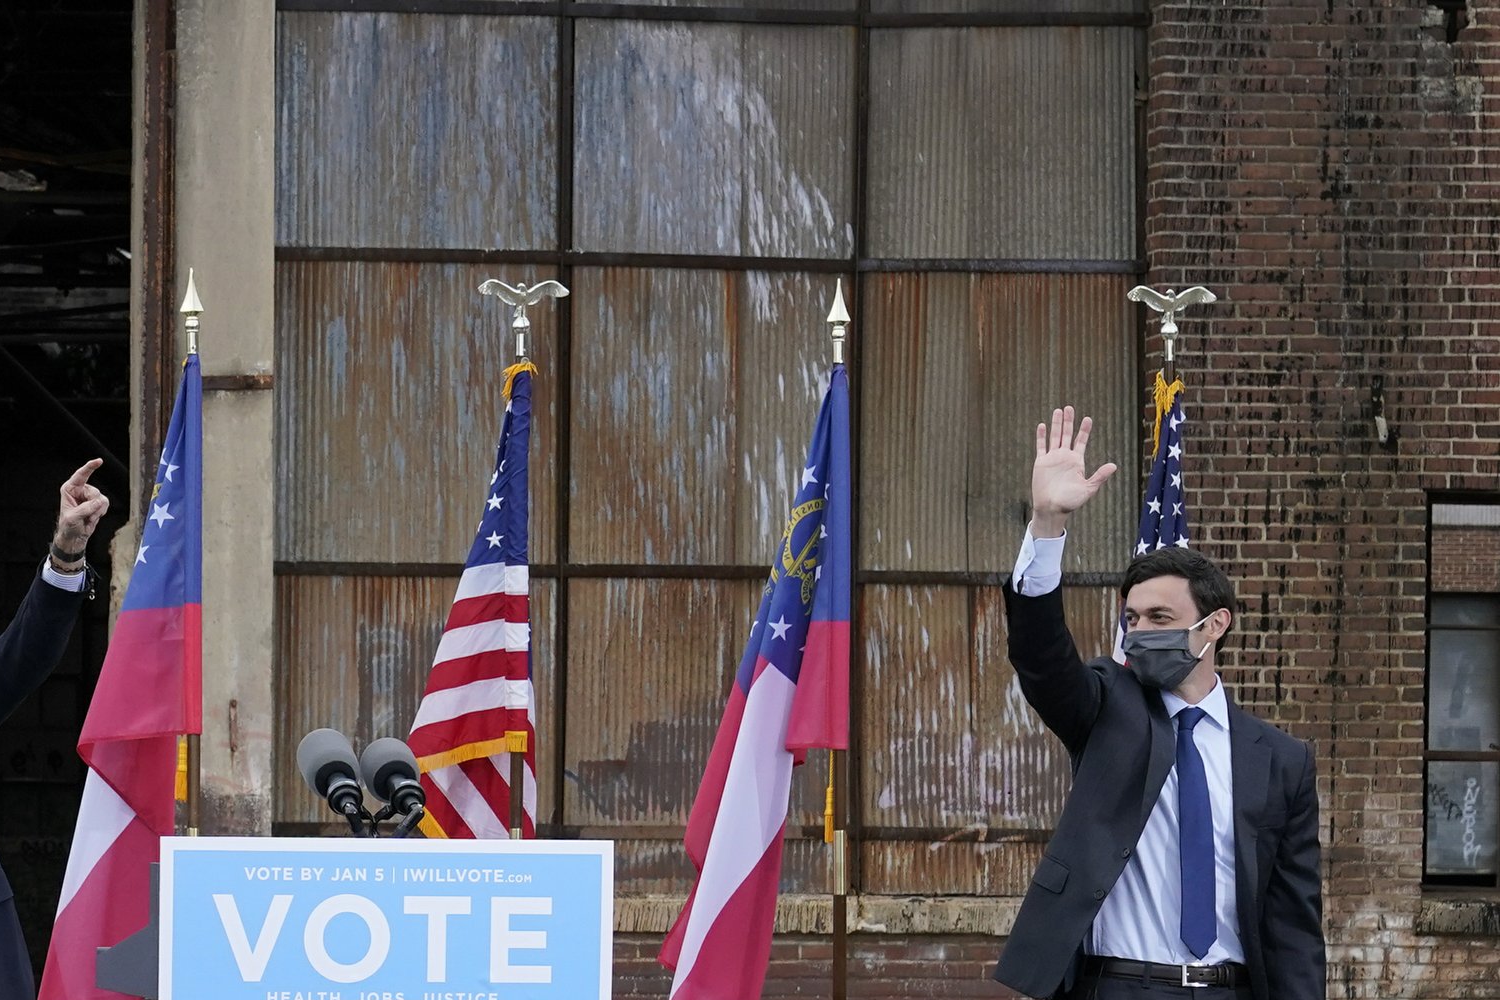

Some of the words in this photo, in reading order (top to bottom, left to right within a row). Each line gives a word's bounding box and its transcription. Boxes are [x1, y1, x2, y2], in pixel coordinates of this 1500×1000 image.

[244, 866, 293, 881] VOTE
[300, 867, 324, 881] BY
[331, 868, 367, 881] JAN
[374, 868, 384, 882] 5
[403, 868, 532, 883] IWILLVOTE.COM
[212, 893, 553, 984] VOTE
